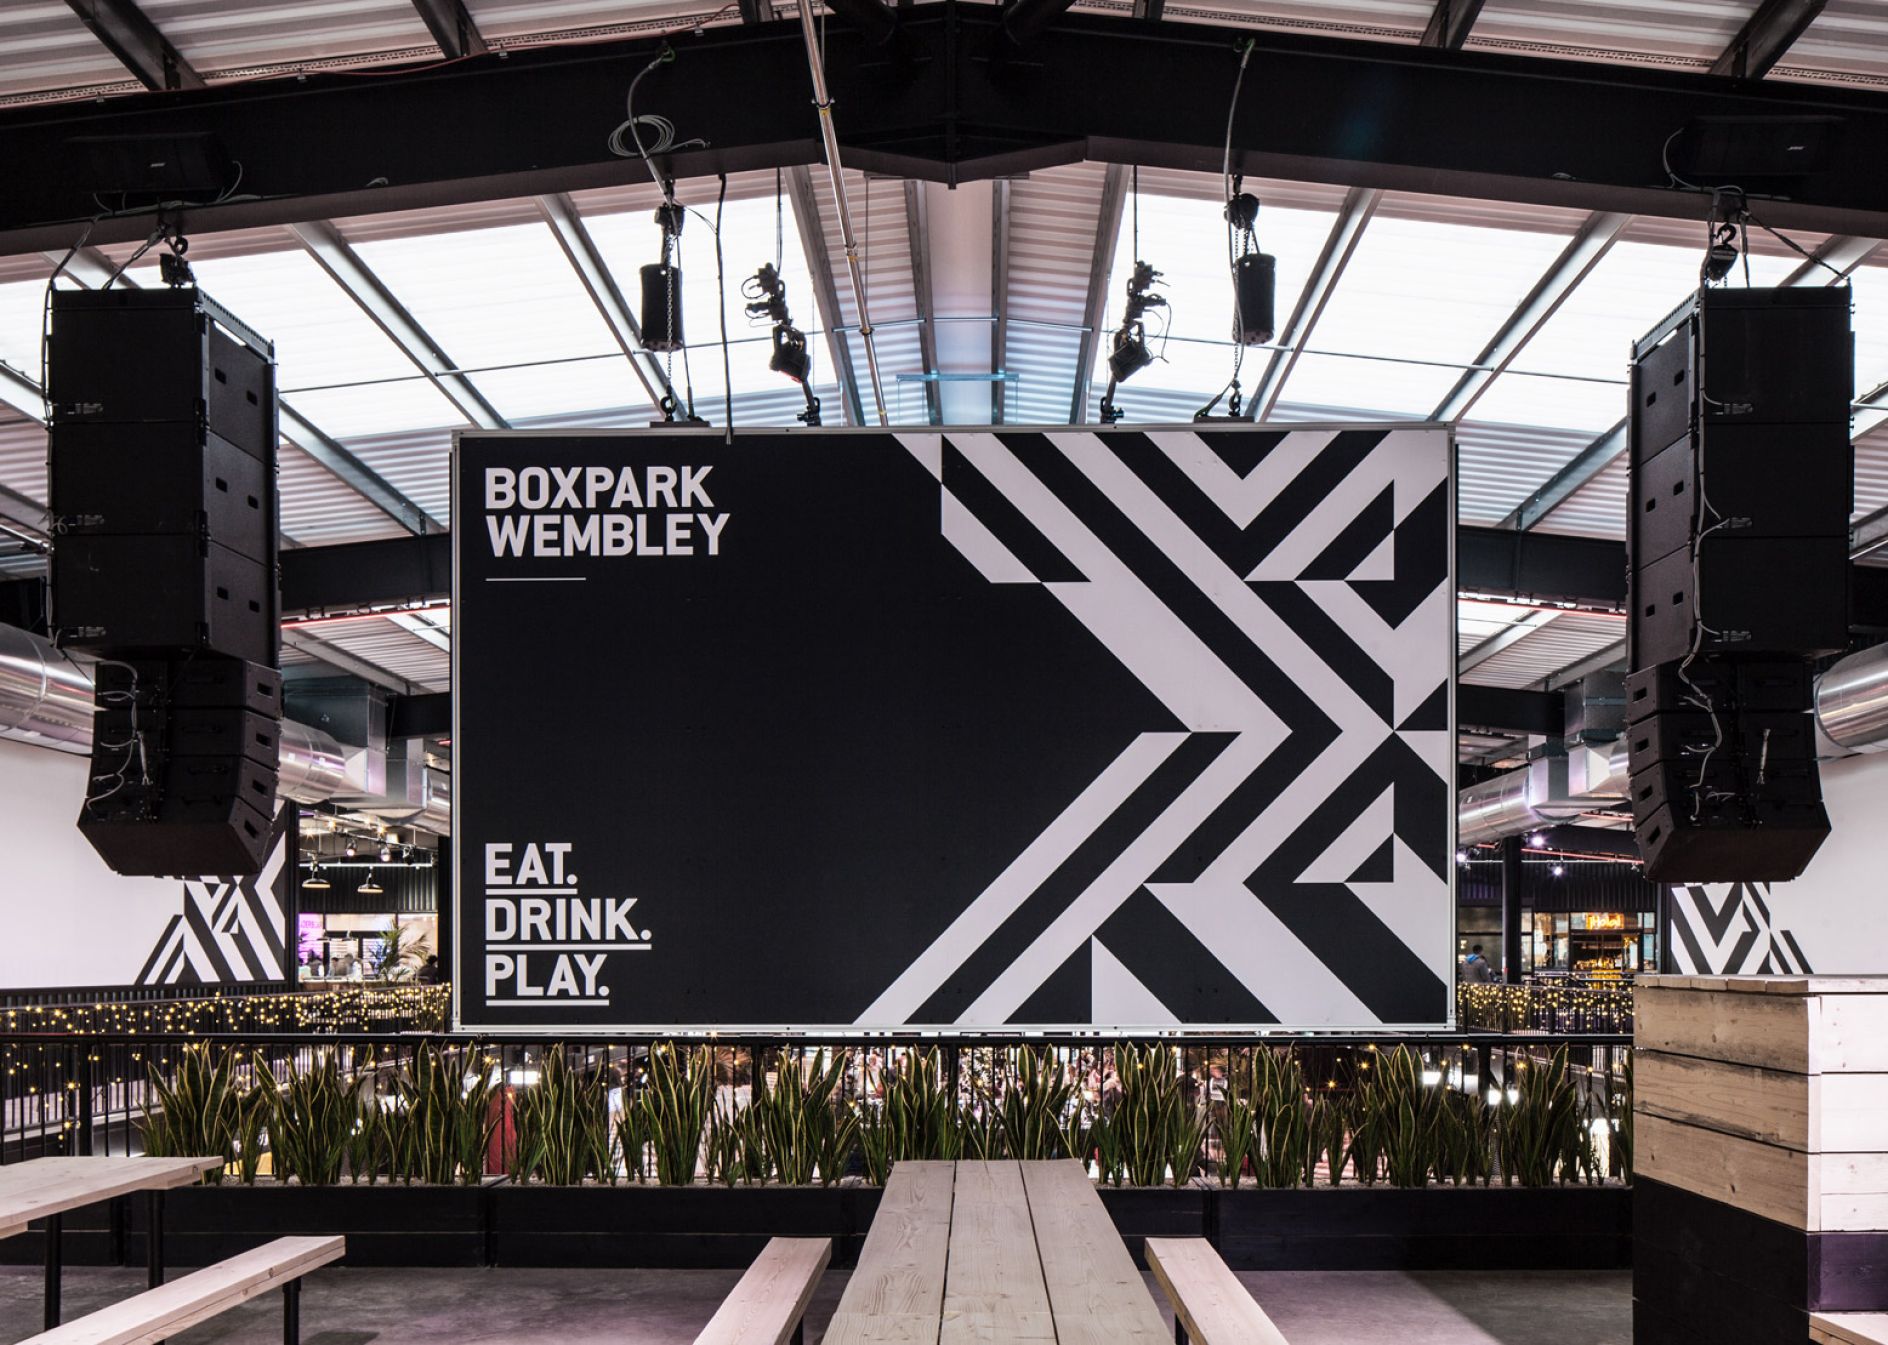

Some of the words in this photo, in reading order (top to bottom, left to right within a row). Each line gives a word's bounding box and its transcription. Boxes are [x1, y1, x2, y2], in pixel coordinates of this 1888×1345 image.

[485, 466, 715, 509] BOXPARK
[485, 513, 730, 557] WEMBLEY
[485, 842, 578, 885] EAT.
[485, 898, 652, 941] DRINK.
[485, 954, 610, 997] PLAY.
